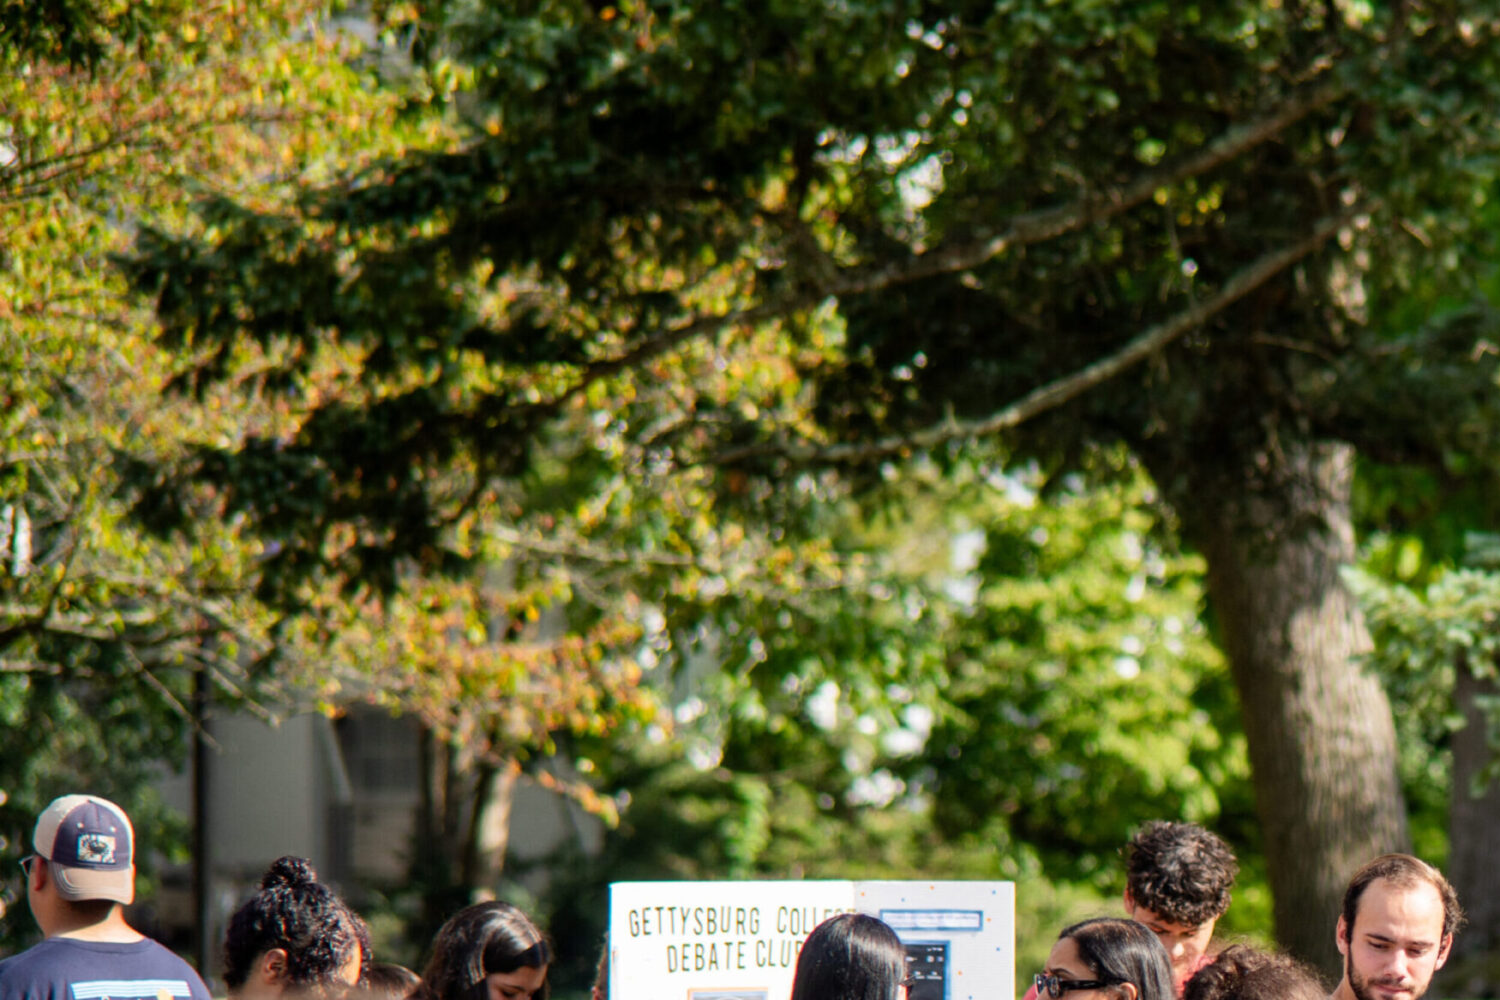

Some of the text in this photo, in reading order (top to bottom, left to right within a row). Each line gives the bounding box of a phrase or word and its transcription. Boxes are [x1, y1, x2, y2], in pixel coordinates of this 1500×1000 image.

[628, 905, 760, 938] GETTYSBURG
[776, 904, 857, 936] COLL
[666, 941, 747, 974] DEBATE
